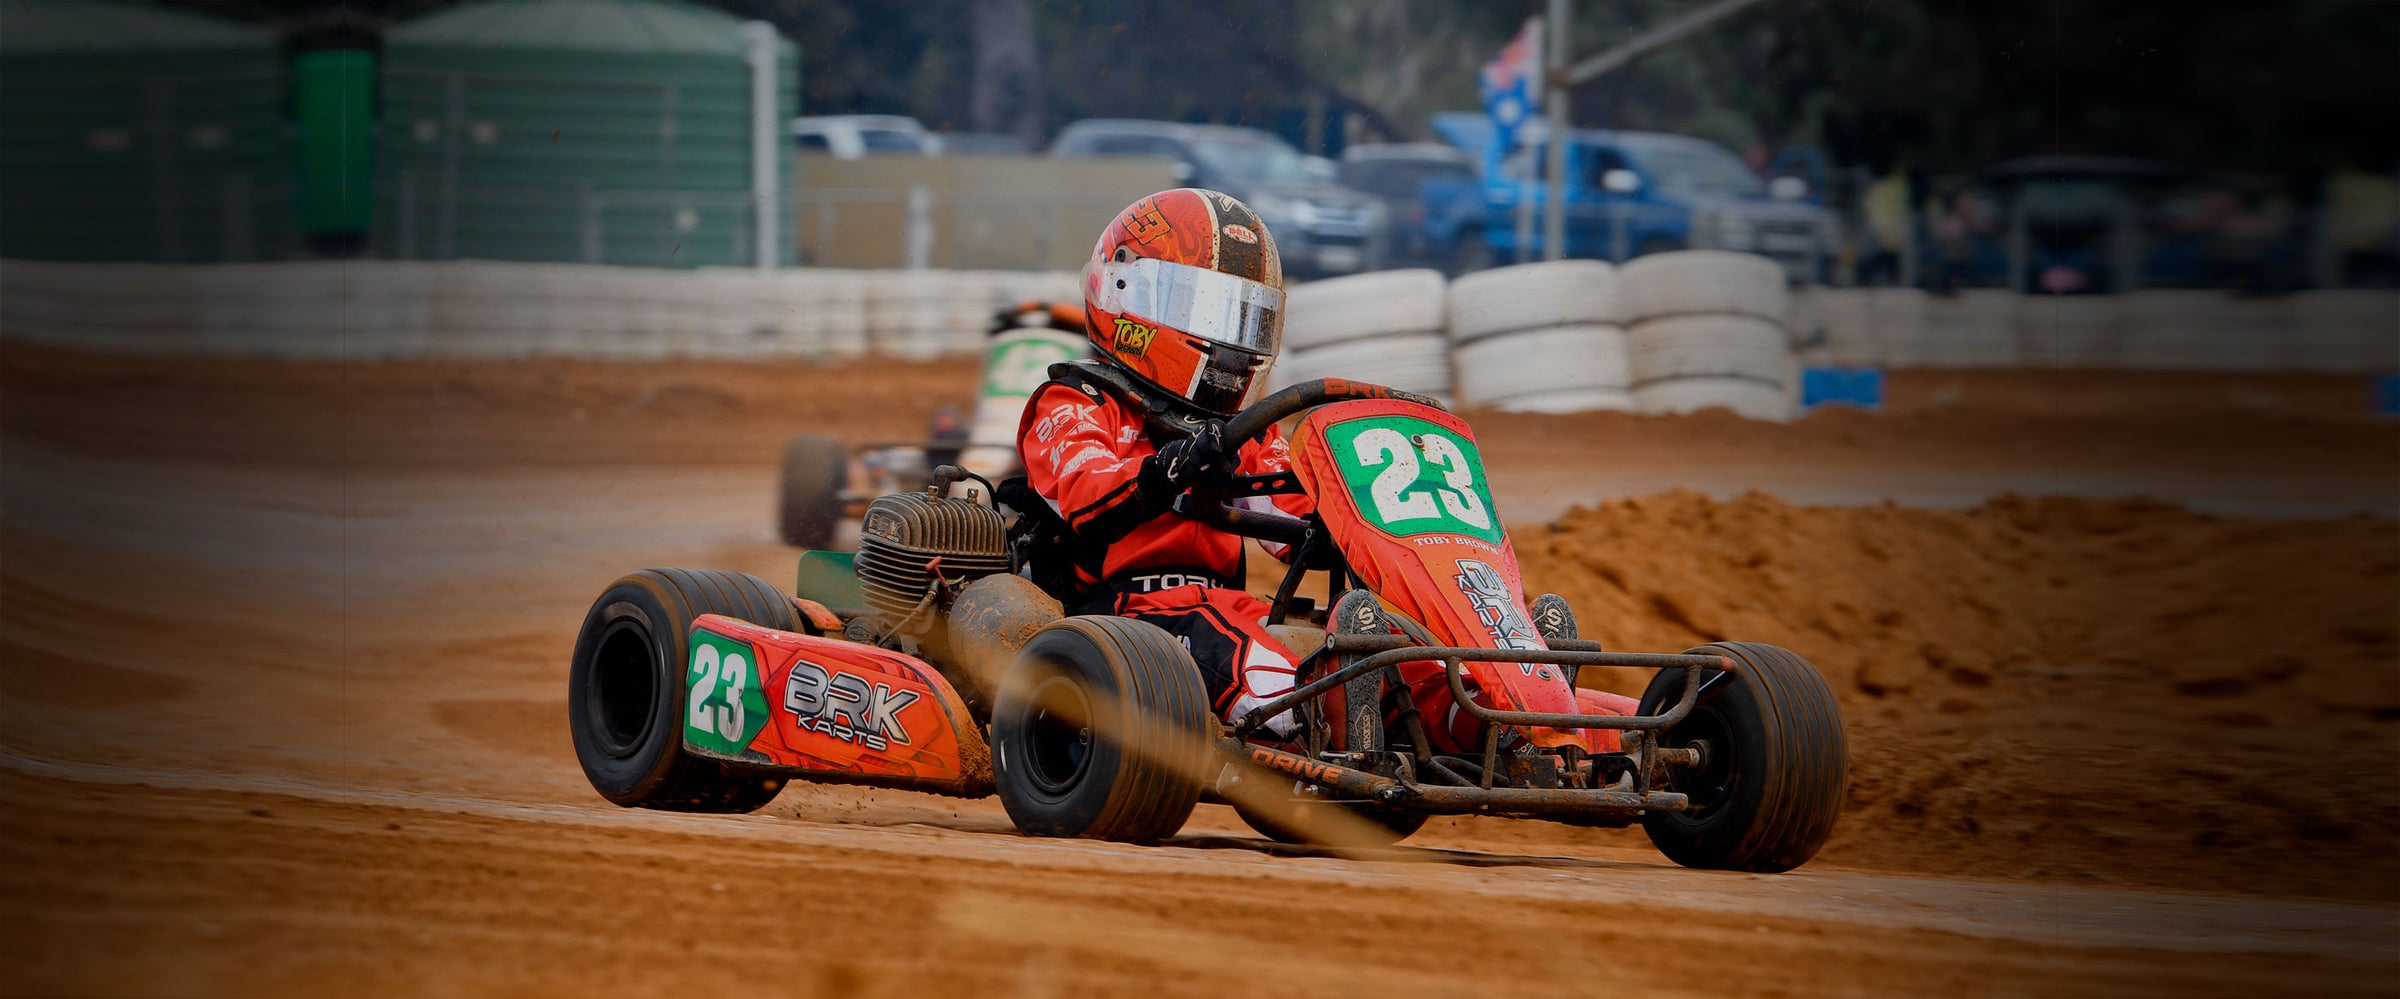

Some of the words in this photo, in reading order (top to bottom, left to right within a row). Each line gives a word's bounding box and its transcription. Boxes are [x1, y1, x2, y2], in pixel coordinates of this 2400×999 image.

[1228, 226, 1255, 241] BELL
[1112, 318, 1158, 361] TOBY
[1323, 377, 1391, 399] BRK
[1036, 403, 1100, 444] BRK
[1352, 428, 1492, 530] 23
[1413, 536, 1451, 547] TOBY
[1455, 537, 1500, 556] BROWN
[690, 643, 747, 742] 23
[784, 659, 920, 746] BRK
[797, 712, 888, 752] KARTS
[1251, 748, 1343, 784] DRIVE
